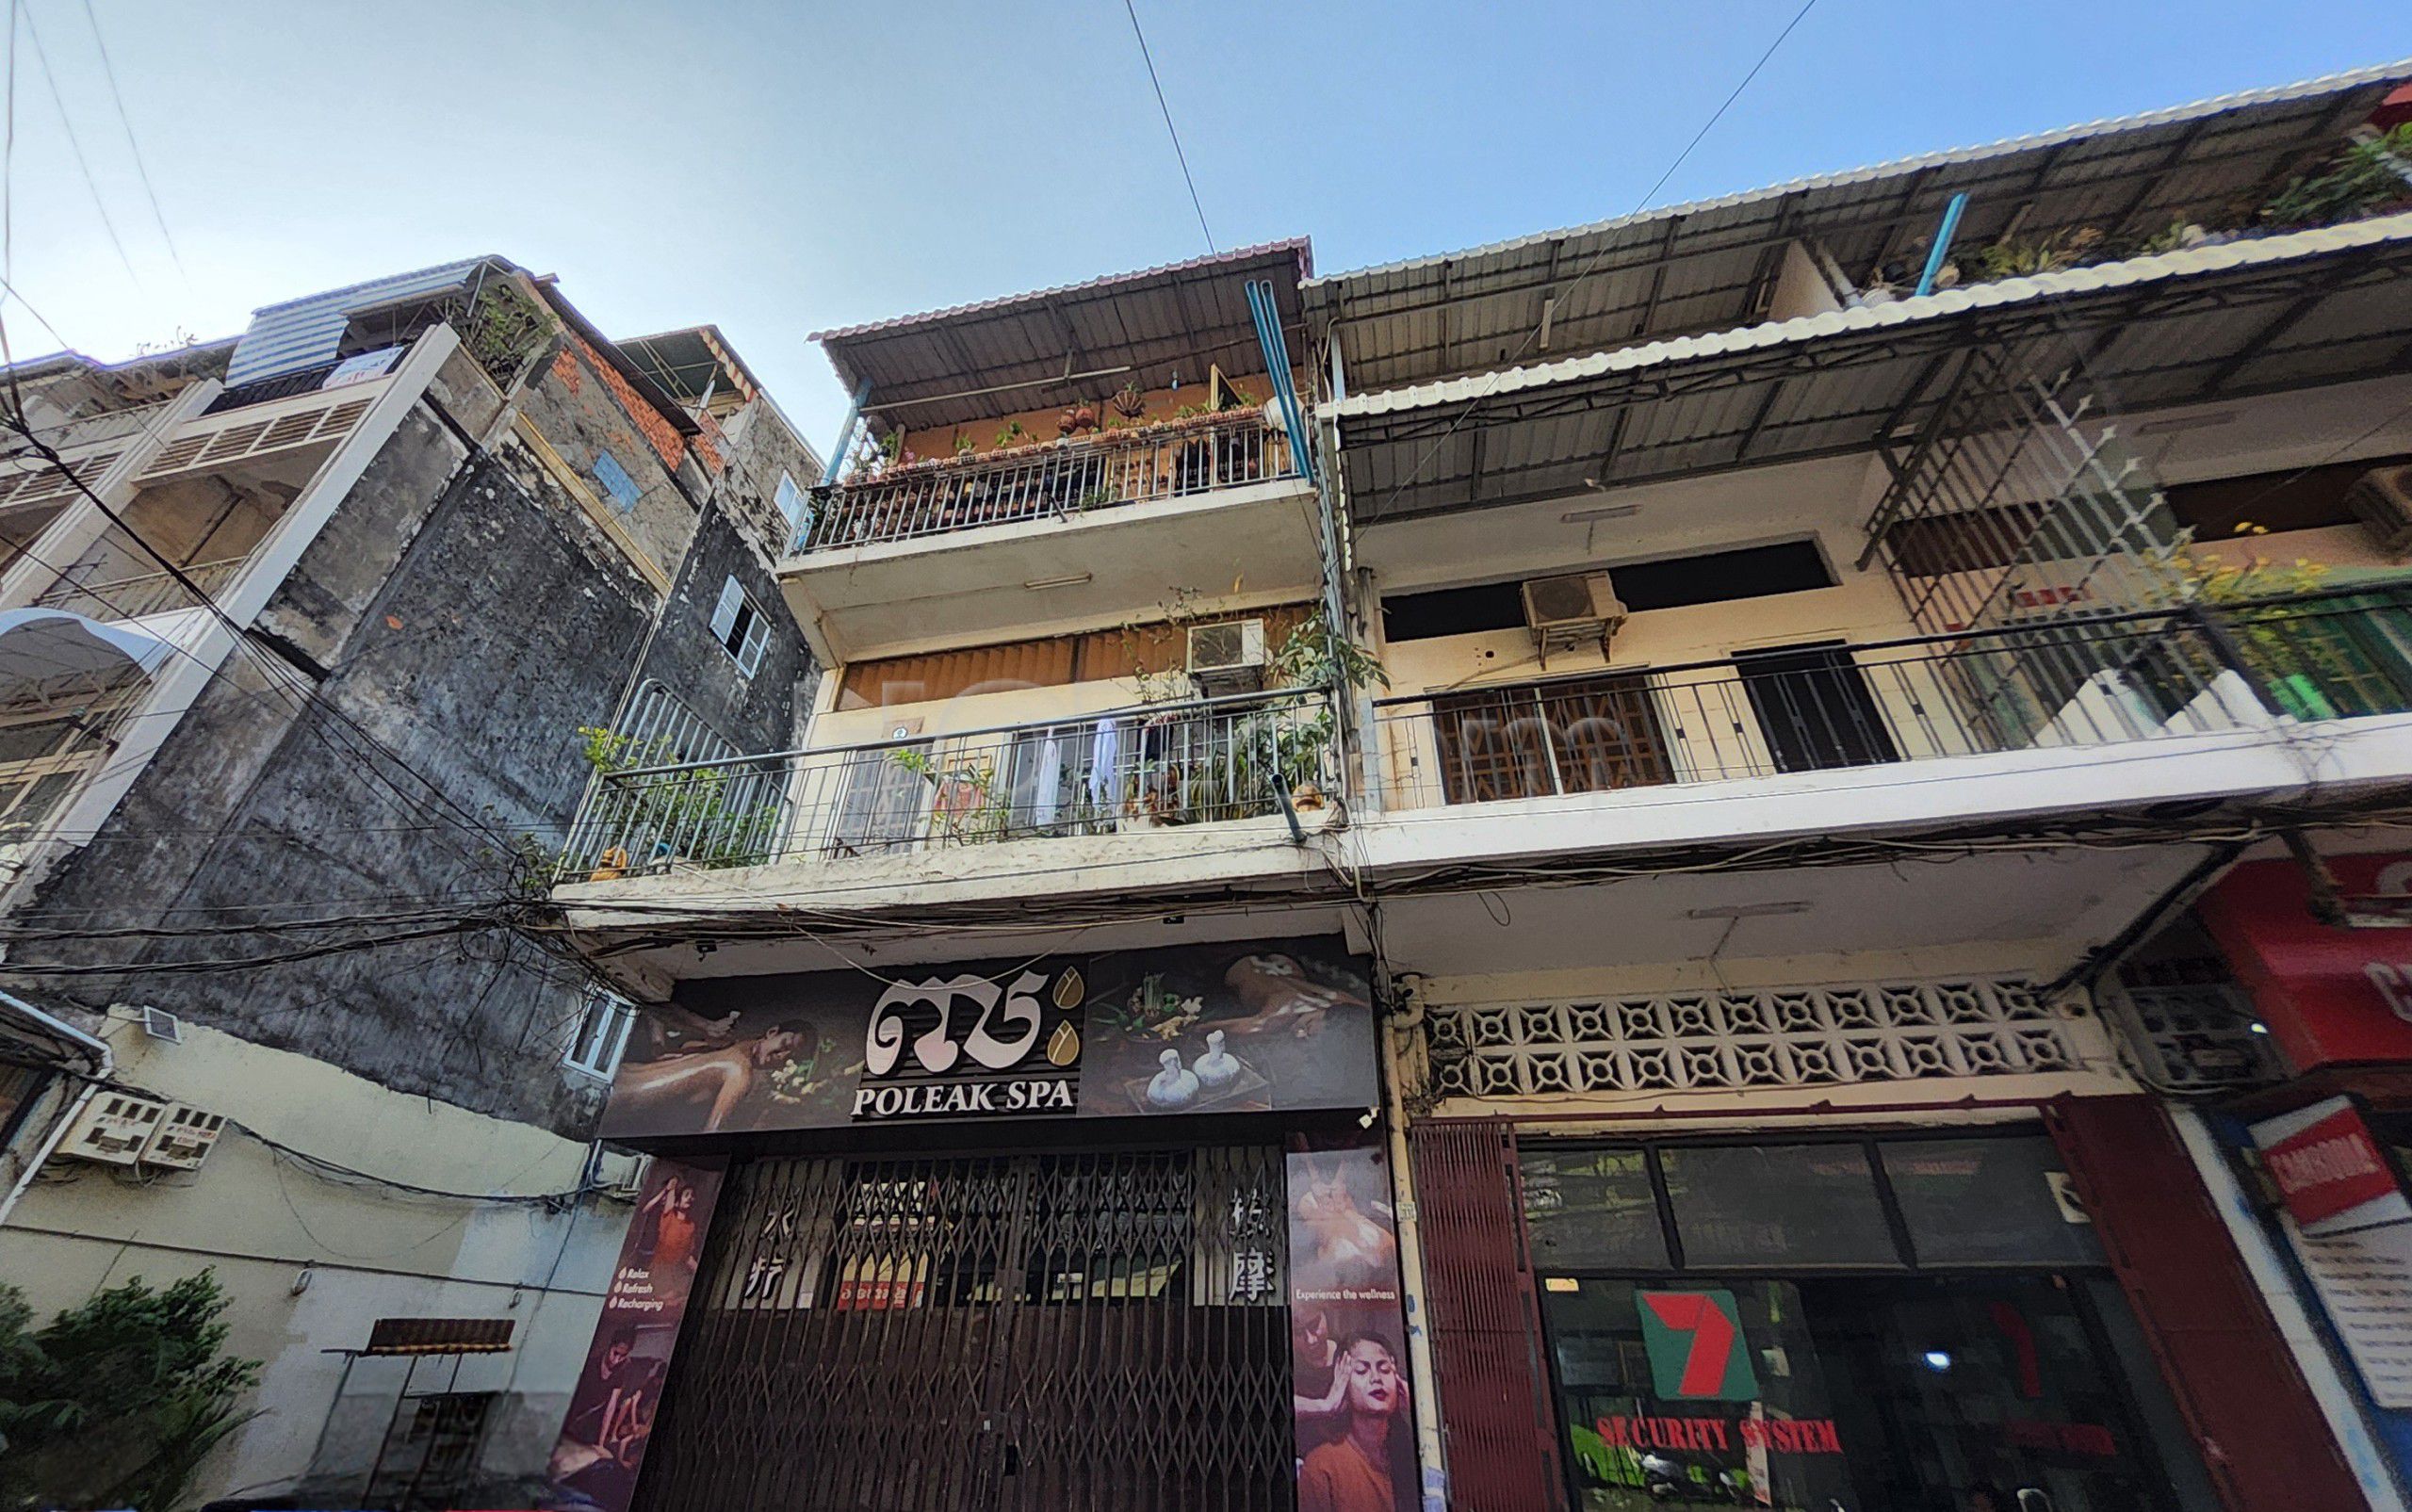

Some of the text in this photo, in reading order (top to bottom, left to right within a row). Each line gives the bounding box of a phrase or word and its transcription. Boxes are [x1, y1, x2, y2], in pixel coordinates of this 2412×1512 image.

[850, 1080, 1074, 1117] POLEAK SPA
[622, 1283, 653, 1293] Refresh
[1296, 1288, 1395, 1301] Experience the wellness
[618, 1297, 663, 1311] Recharging
[1596, 1416, 1843, 1454] SECURITY SYSTEM
